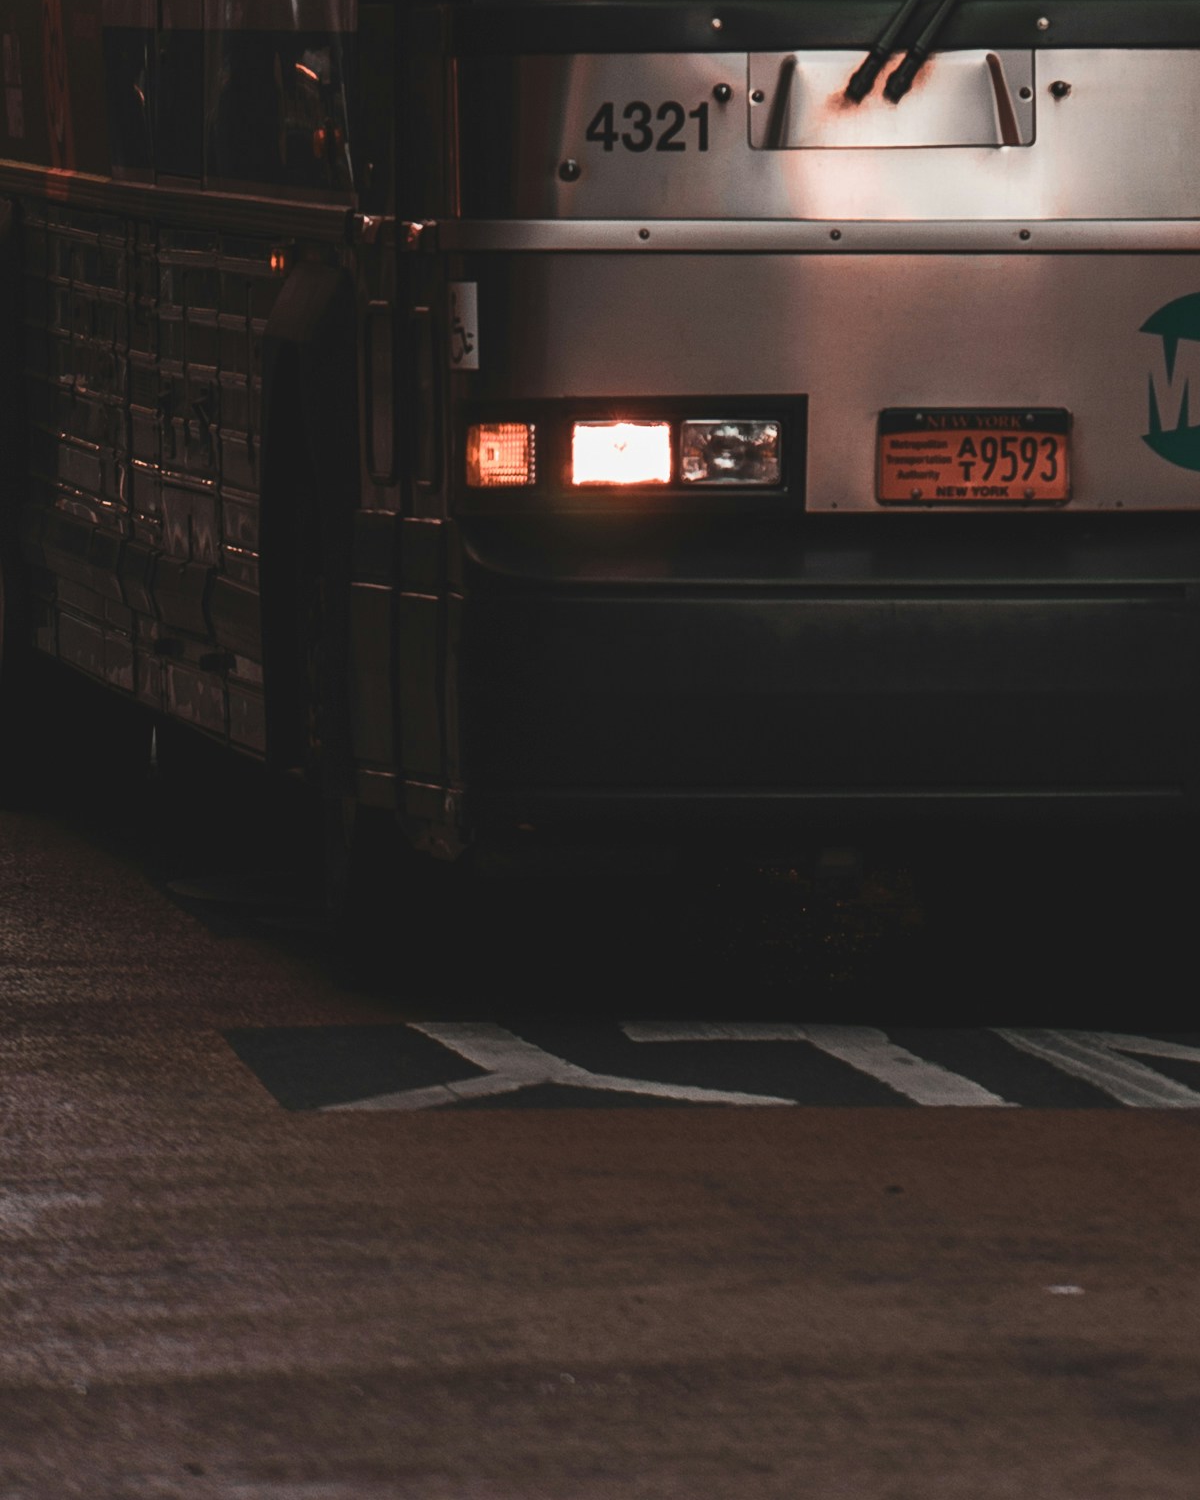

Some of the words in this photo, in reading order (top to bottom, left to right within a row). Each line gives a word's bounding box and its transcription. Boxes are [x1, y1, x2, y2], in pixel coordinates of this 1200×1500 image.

[585, 101, 709, 153] 4321
[927, 414, 969, 429] NEW
[976, 414, 1023, 429] YORK
[936, 486, 969, 497] NEW
[972, 486, 1009, 497] YORK
